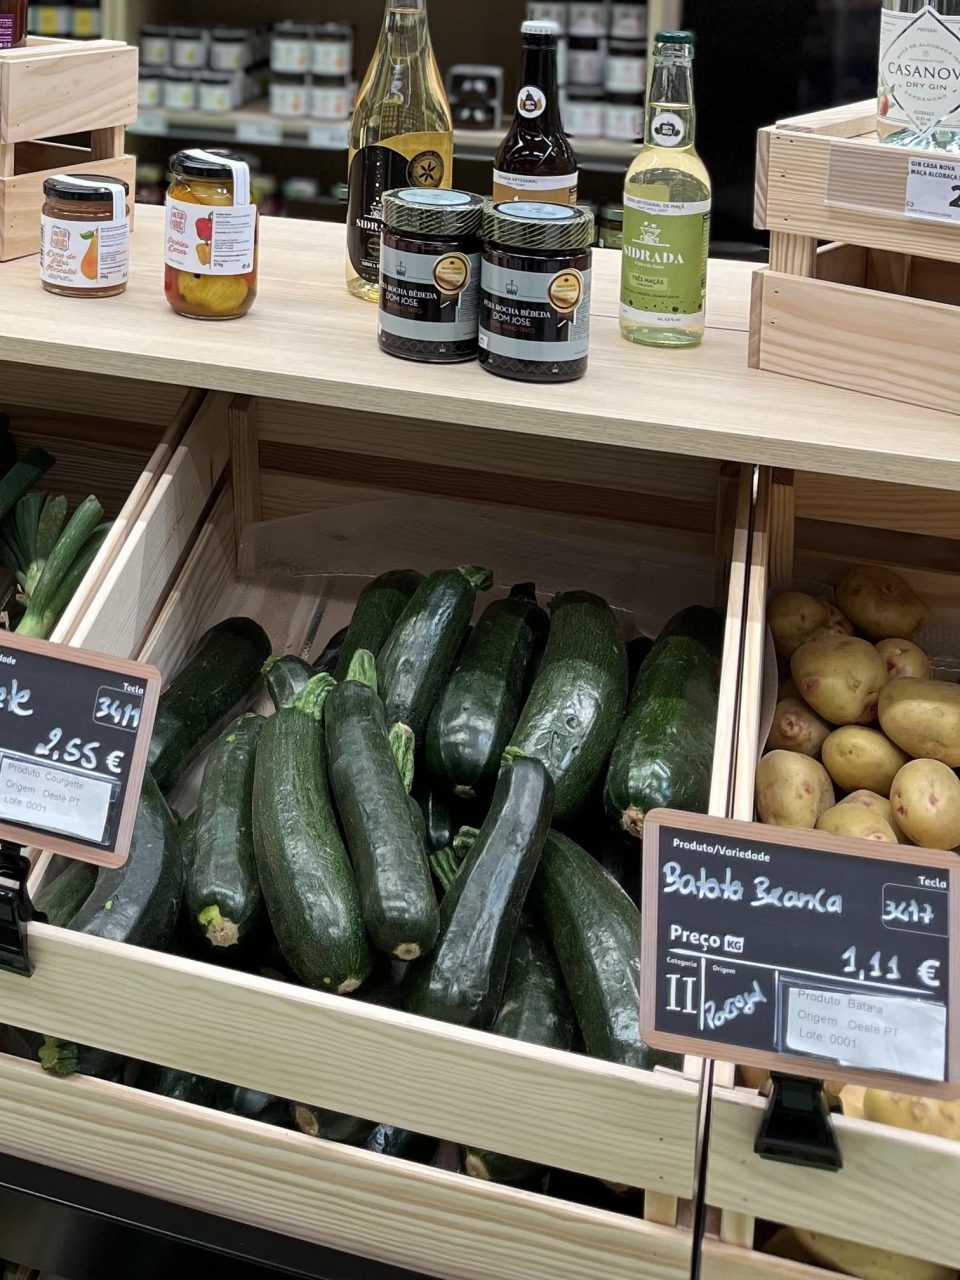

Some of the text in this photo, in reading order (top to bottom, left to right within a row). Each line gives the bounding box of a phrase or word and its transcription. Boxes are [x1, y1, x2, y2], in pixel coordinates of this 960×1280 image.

[906, 81, 947, 91] DRY GIN
[922, 162, 938, 170] CASA
[624, 244, 685, 264] SIDRADA
[385, 292, 400, 303] DOM
[387, 285, 408, 296] ROCHA
[408, 290, 438, 300] BÊBEDA
[492, 311, 510, 323] DOM
[495, 304, 519, 316] ROCHA
[520, 309, 551, 318] BÊBEDA
[123, 682, 144, 695] Tecla
[106, 750, 125, 773] €
[673, 837, 771, 863] Produto/Variedade
[918, 875, 947, 889] Tecla
[670, 924, 742, 951] Preço KG
[666, 956, 736, 975] Categoria Origem
[841, 945, 941, 987] 1,11 €
[666, 974, 698, 1014] II
